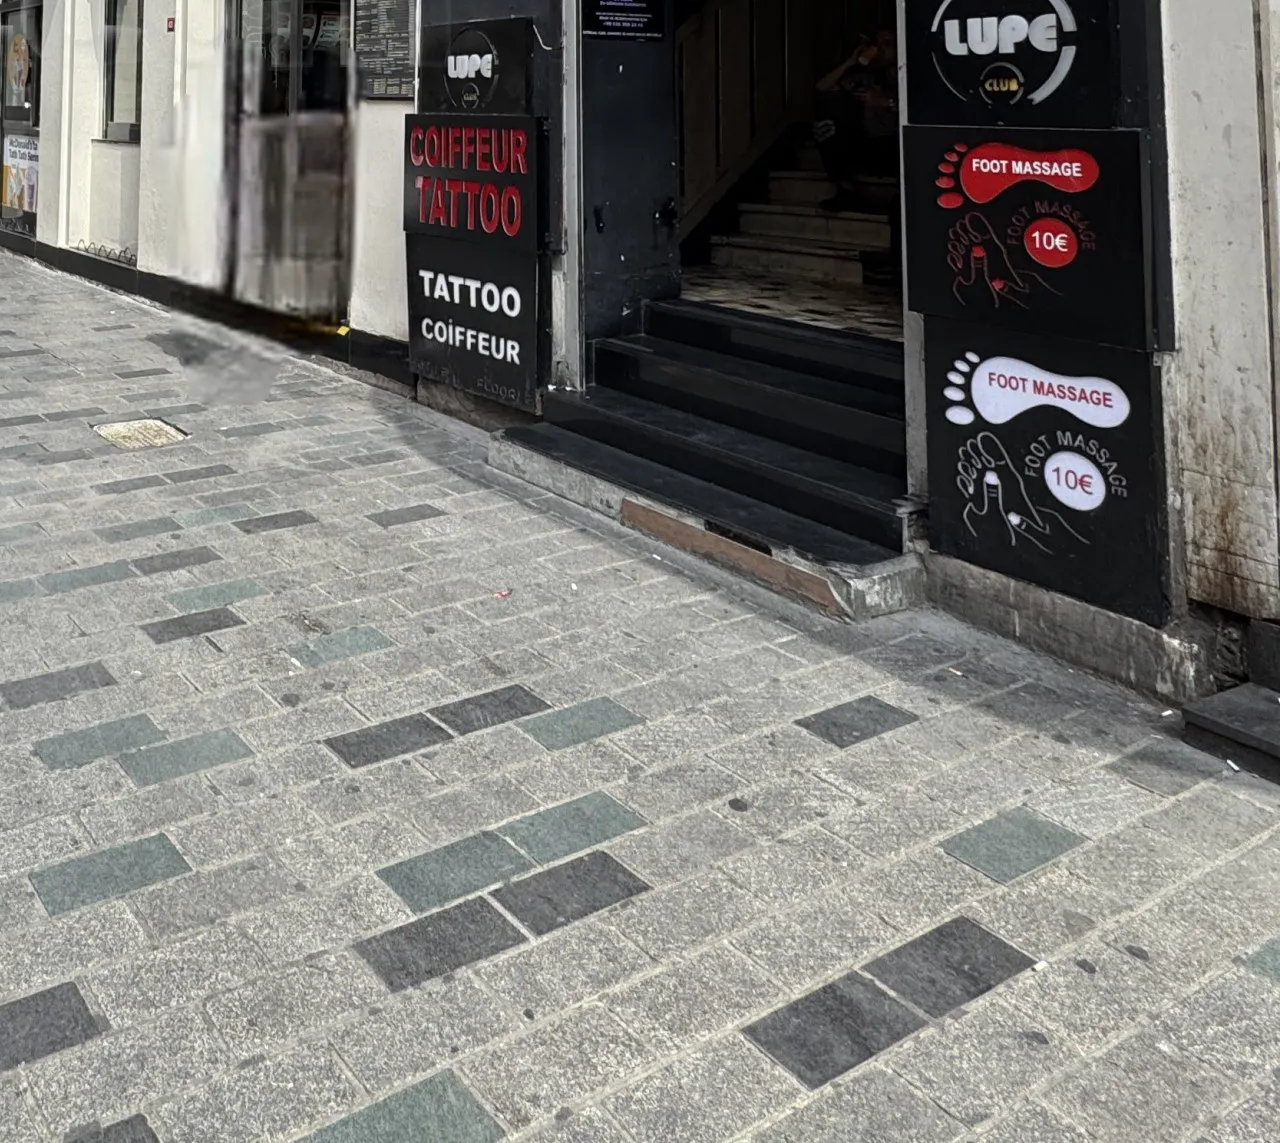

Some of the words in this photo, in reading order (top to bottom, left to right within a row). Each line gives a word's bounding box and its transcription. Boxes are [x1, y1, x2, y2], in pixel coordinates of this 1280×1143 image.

[943, 13, 1058, 56] LUPE
[447, 53, 493, 79] LUPE
[984, 78, 1019, 92] CLUB
[410, 125, 528, 175] COIFFEUR
[972, 158, 1008, 175] FOOT
[1012, 159, 1083, 177] MASSAGE
[415, 175, 523, 237] TATTOO
[1031, 230, 1069, 253] 10€
[419, 269, 521, 318] TATTOO
[988, 372, 1029, 394] FOOT
[1033, 380, 1114, 408] MASSAGE
[1024, 434, 1053, 478] FOOT
[1056, 430, 1128, 498] MASSAGE
[1051, 465, 1094, 495] 10€
